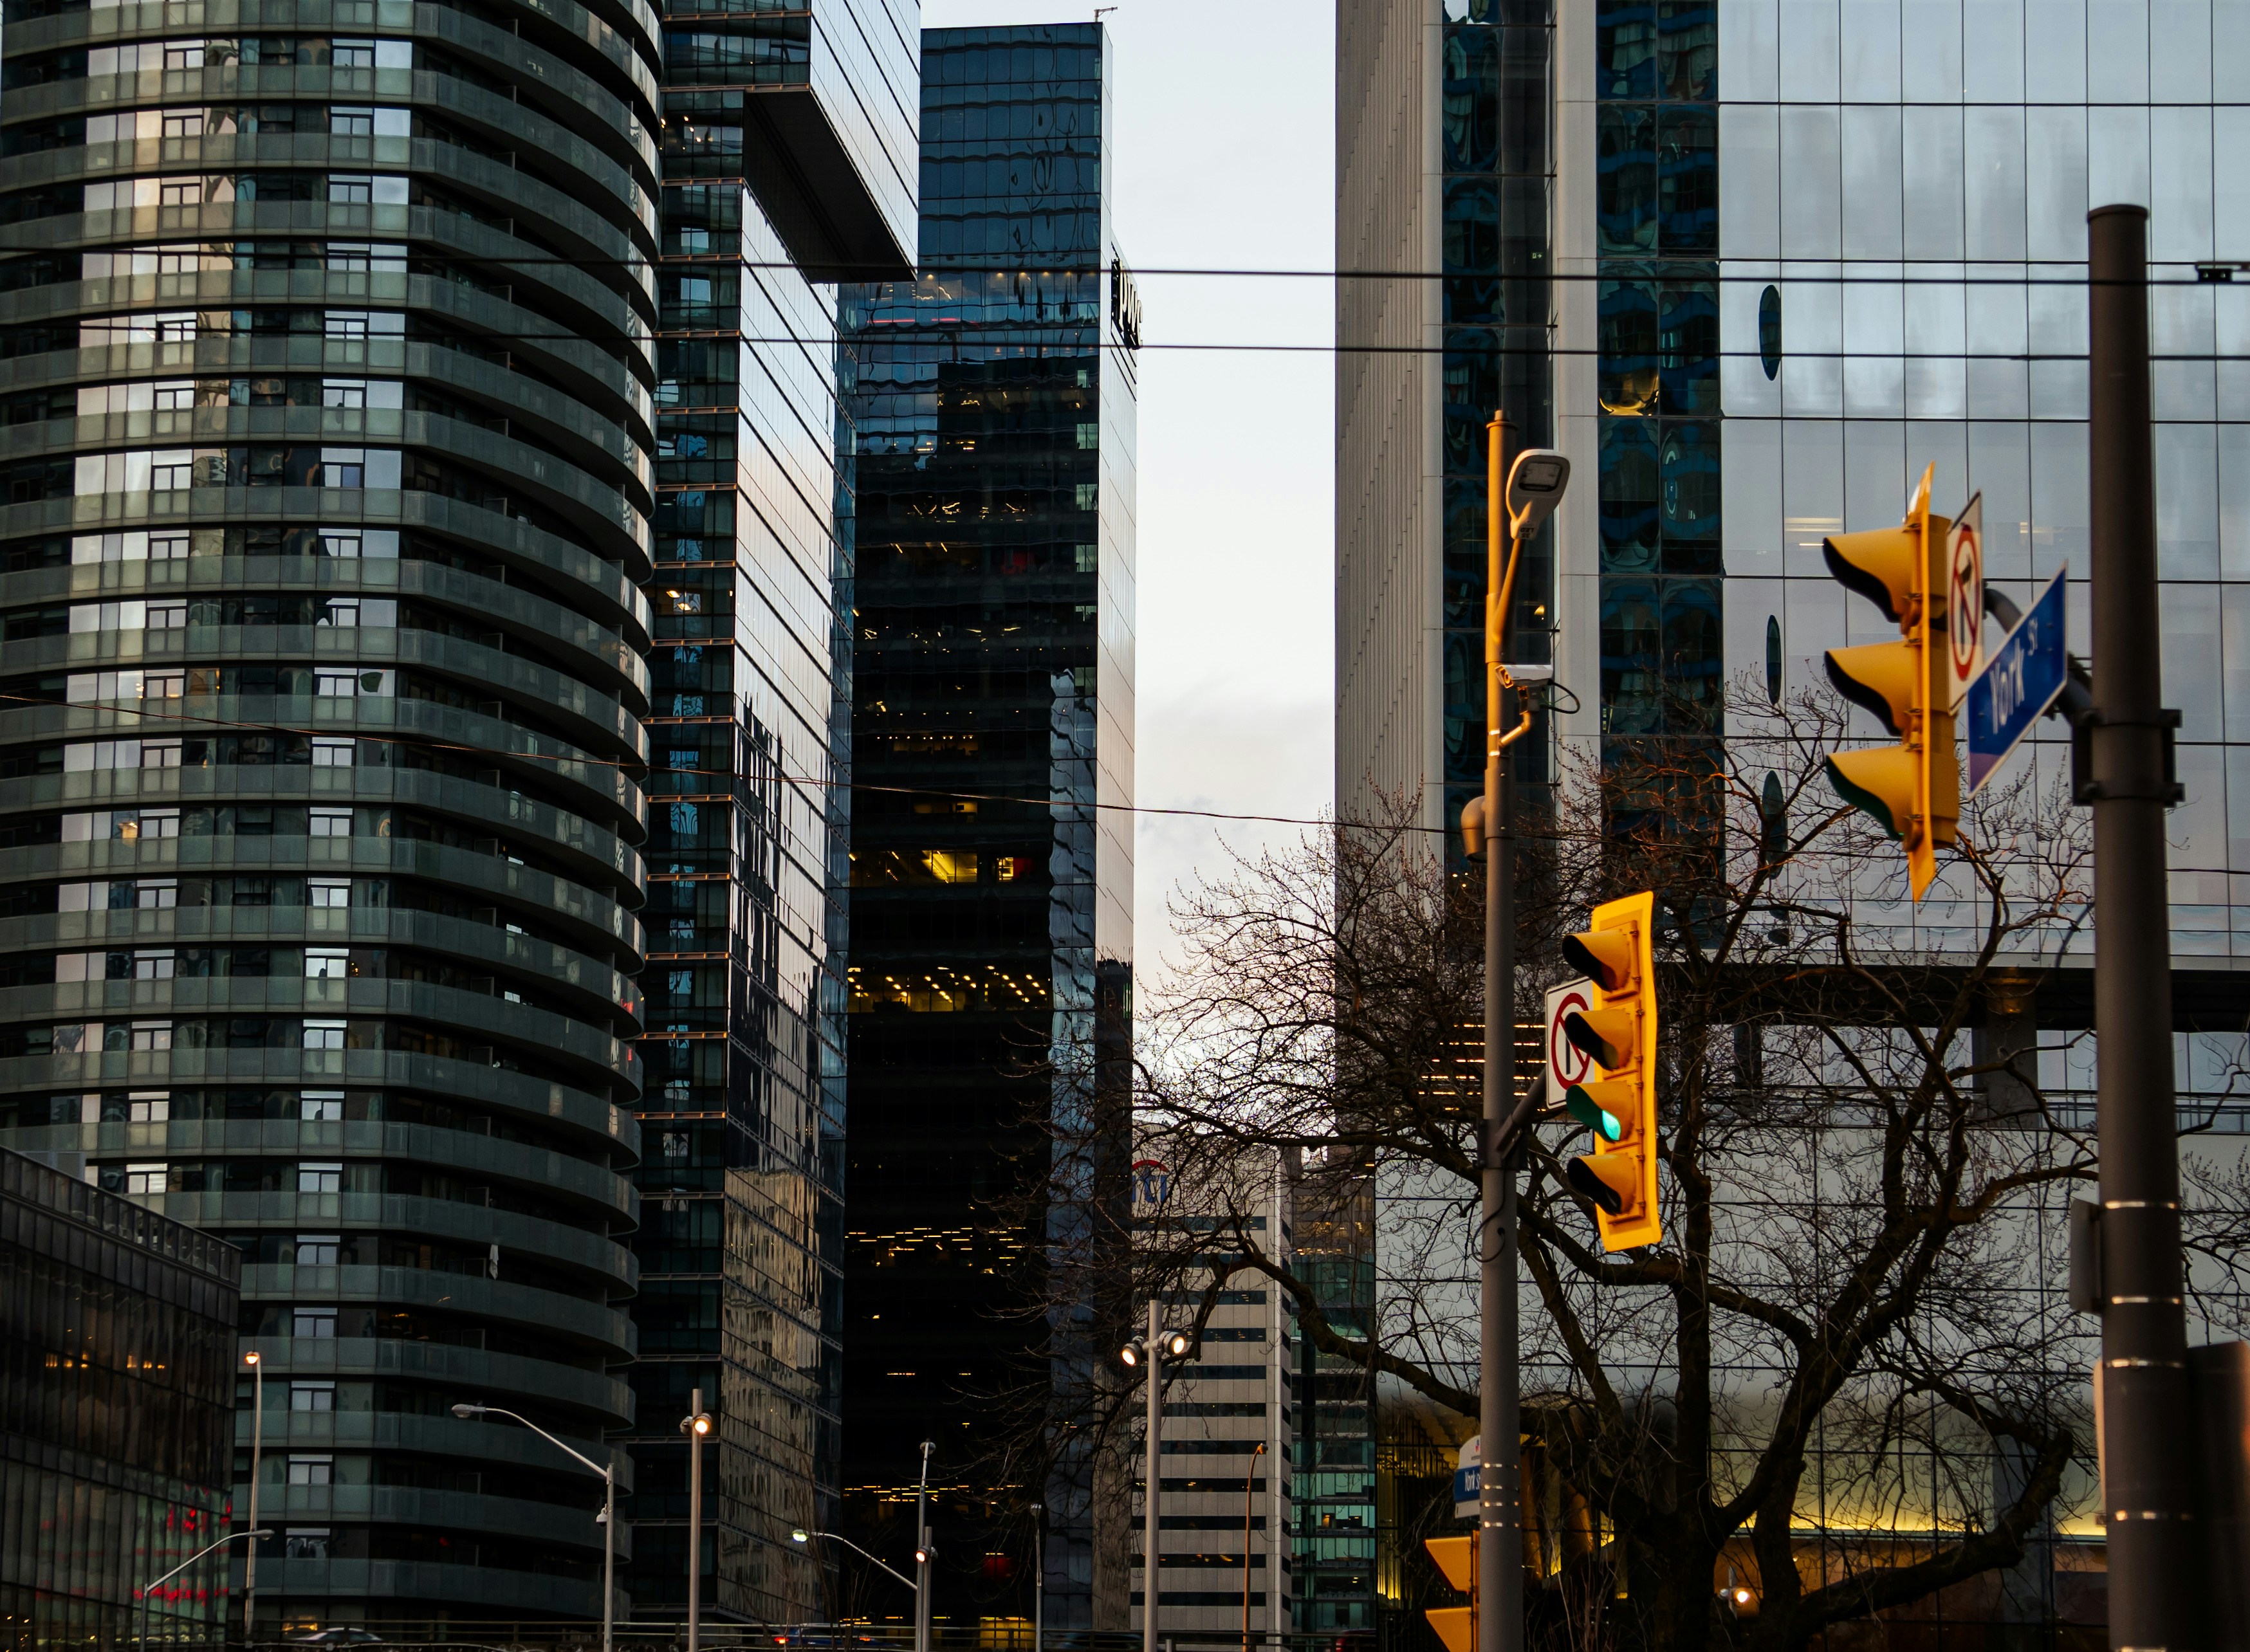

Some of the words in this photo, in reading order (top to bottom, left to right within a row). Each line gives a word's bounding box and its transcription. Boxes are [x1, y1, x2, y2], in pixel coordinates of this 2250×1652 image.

[1119, 259, 1143, 348] pwc
[1989, 638, 2025, 735] York
[1132, 1168, 1167, 1203] iti
[1464, 1470, 1475, 1492] York
[1475, 1473, 1480, 1491] S
